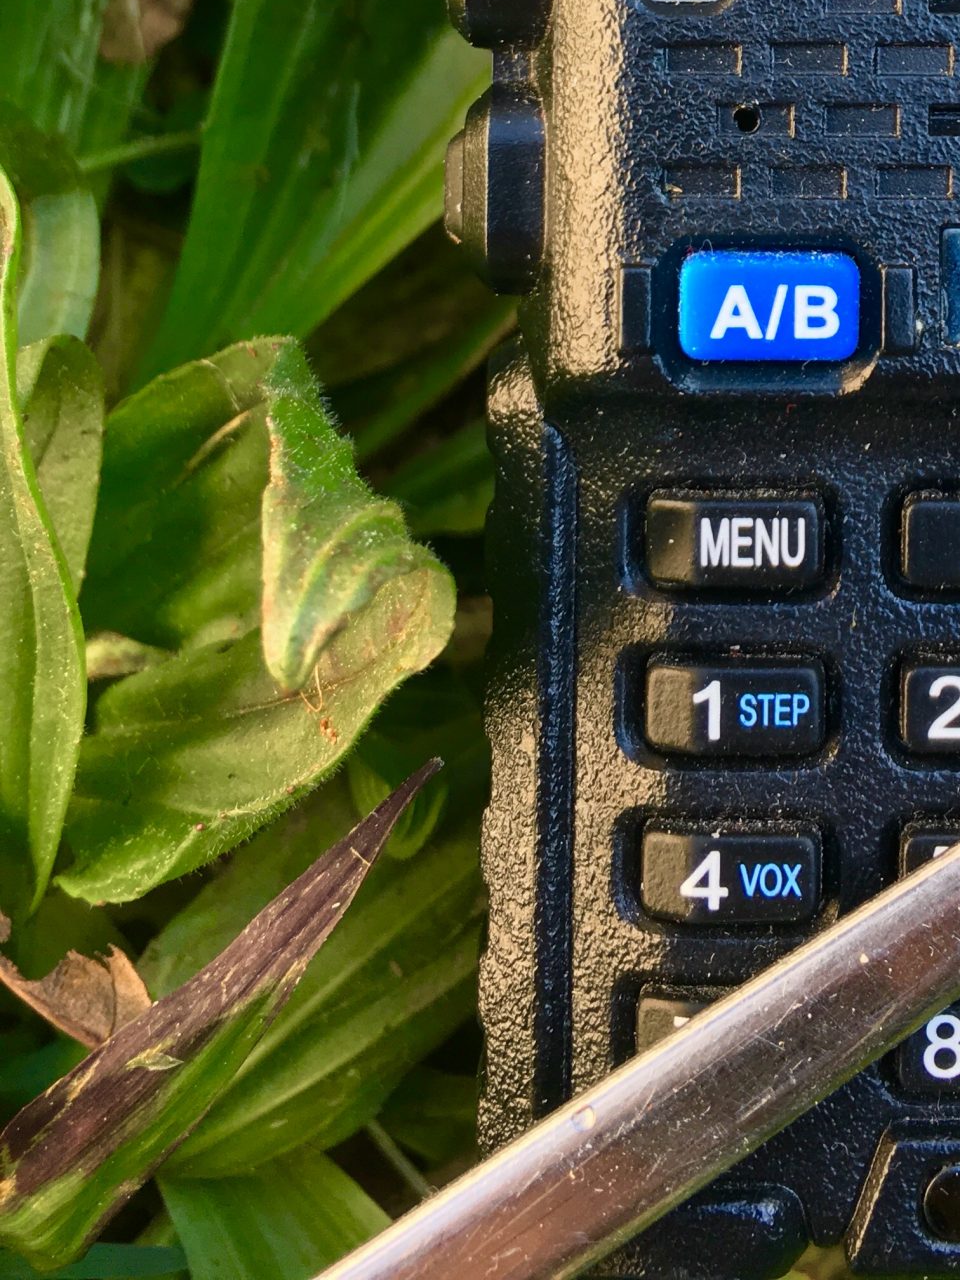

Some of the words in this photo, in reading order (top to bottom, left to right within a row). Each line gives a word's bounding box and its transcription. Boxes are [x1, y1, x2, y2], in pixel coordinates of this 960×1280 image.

[709, 284, 840, 340] A/B
[700, 516, 805, 568] MENU
[692, 680, 721, 741] 1
[739, 693, 810, 727] STEP
[679, 851, 729, 911] 4
[740, 863, 802, 898] VOX
